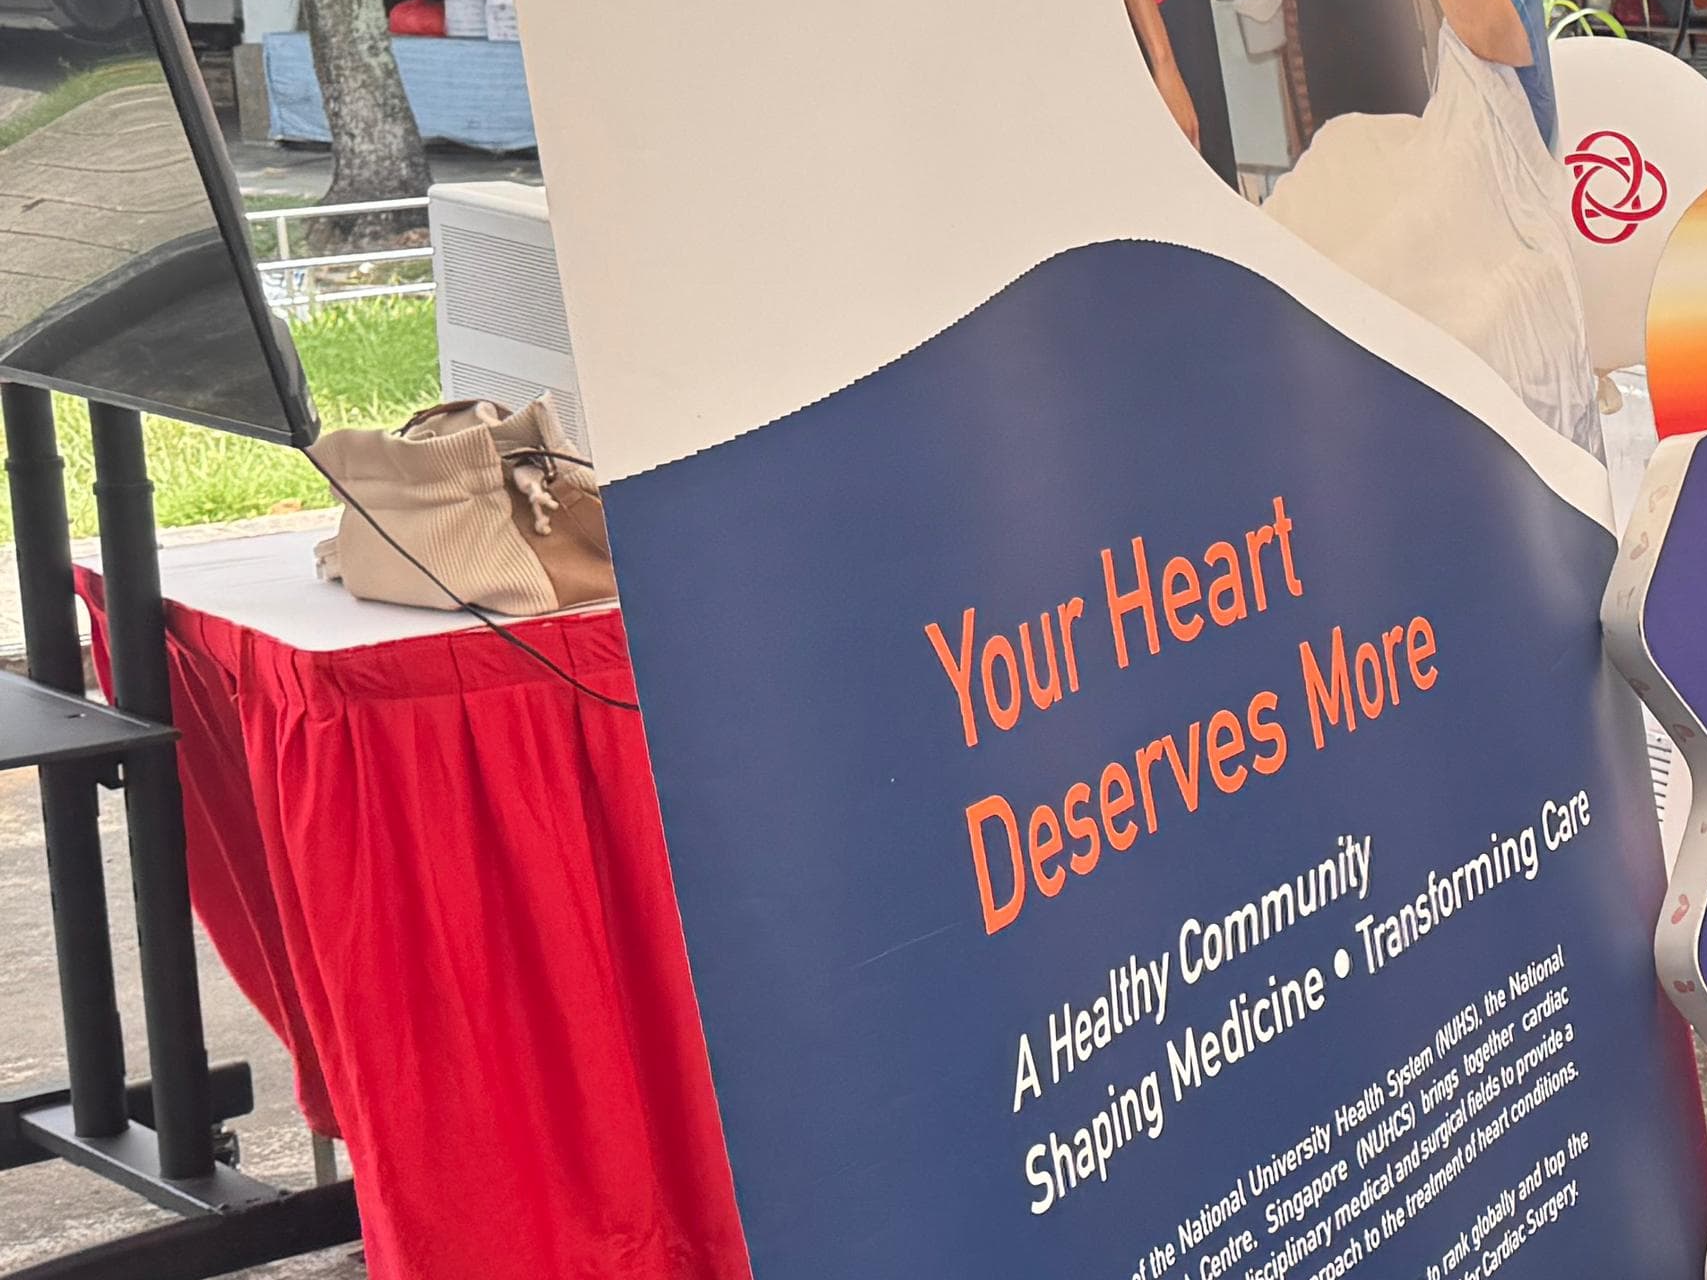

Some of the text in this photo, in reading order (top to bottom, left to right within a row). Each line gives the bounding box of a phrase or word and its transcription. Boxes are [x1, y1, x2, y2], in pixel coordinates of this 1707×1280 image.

[925, 496, 1303, 749] Your Heart
[964, 615, 1441, 937] Deserves More
[1011, 833, 1374, 1114] A Healthy Community
[1024, 789, 1592, 1216] Shaping Medicine Transforming Care
[1149, 1242, 1175, 1278] the
[1177, 1179, 1246, 1253] National
[1248, 1124, 1330, 1195] University
[1334, 1082, 1384, 1136] Health
[1386, 1046, 1433, 1097] System
[1483, 989, 1506, 1016] the
[1508, 944, 1564, 999] National
[1265, 1160, 1347, 1232] Singapore
[1356, 1101, 1415, 1168] (NUHCS)
[1420, 1068, 1459, 1113] brings
[1463, 1023, 1514, 1075] together
[1521, 986, 1568, 1031] cardiac
[1334, 1163, 1394, 1229] medical
[1394, 1140, 1420, 1182] and
[1420, 1098, 1467, 1159] surgical
[1466, 1075, 1500, 1117] fields
[1500, 1065, 1514, 1088] to
[1515, 1028, 1563, 1083] provide
[1564, 1022, 1573, 1042] a
[1363, 1227, 1380, 1252] to
[1380, 1207, 1405, 1238] the
[1405, 1147, 1464, 1217] treatment
[1464, 1131, 1477, 1163] of
[1476, 1106, 1510, 1151] heart
[1510, 1061, 1578, 1122] conditions.
[1442, 1231, 1470, 1275] rank
[1471, 1189, 1515, 1251] globally
[1518, 1161, 1542, 1200] and
[1543, 1149, 1565, 1178] top
[1567, 1131, 1588, 1159] the
[1481, 1223, 1526, 1276] Cardiac
[1525, 1179, 1578, 1234] Surgery.
